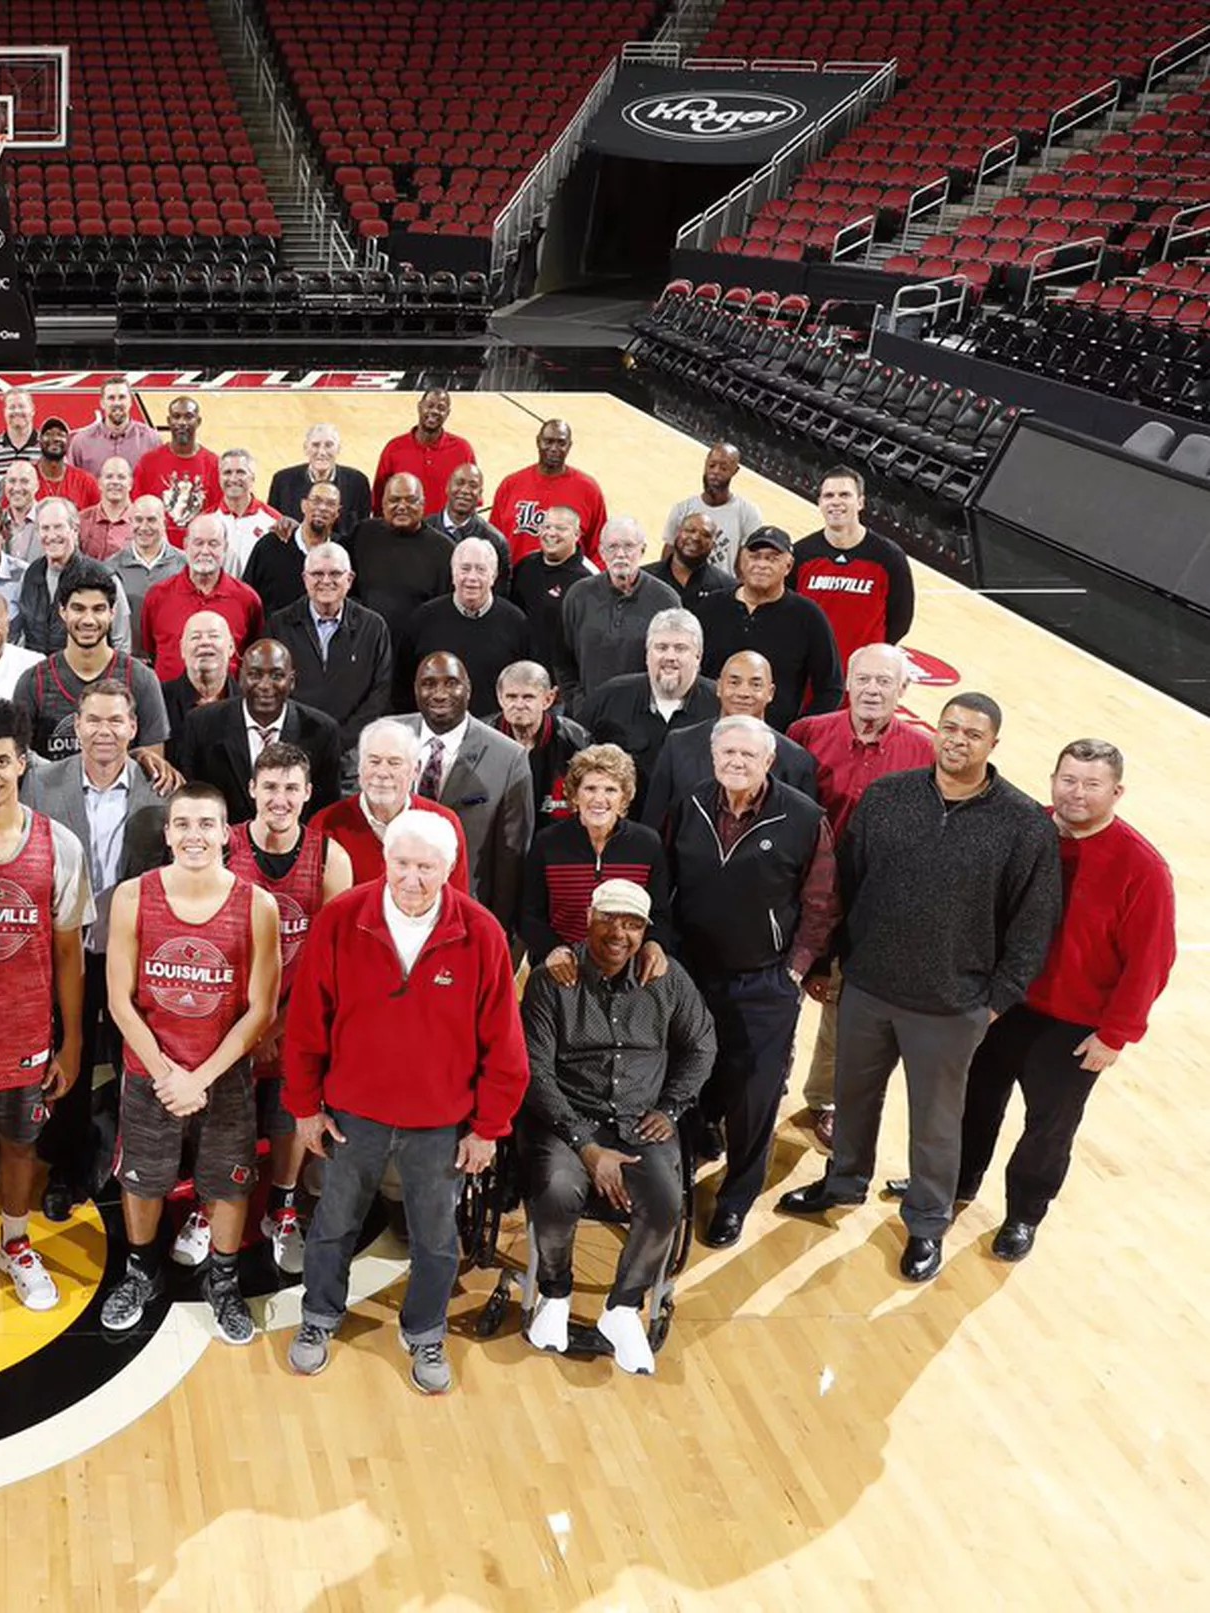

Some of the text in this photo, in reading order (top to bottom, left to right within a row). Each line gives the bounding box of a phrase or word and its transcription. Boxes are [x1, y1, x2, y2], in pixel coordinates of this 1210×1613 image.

[648, 98, 785, 133] Kroger
[807, 575, 875, 595] LOUISVILLE
[144, 961, 234, 984] LOUISVILLE
